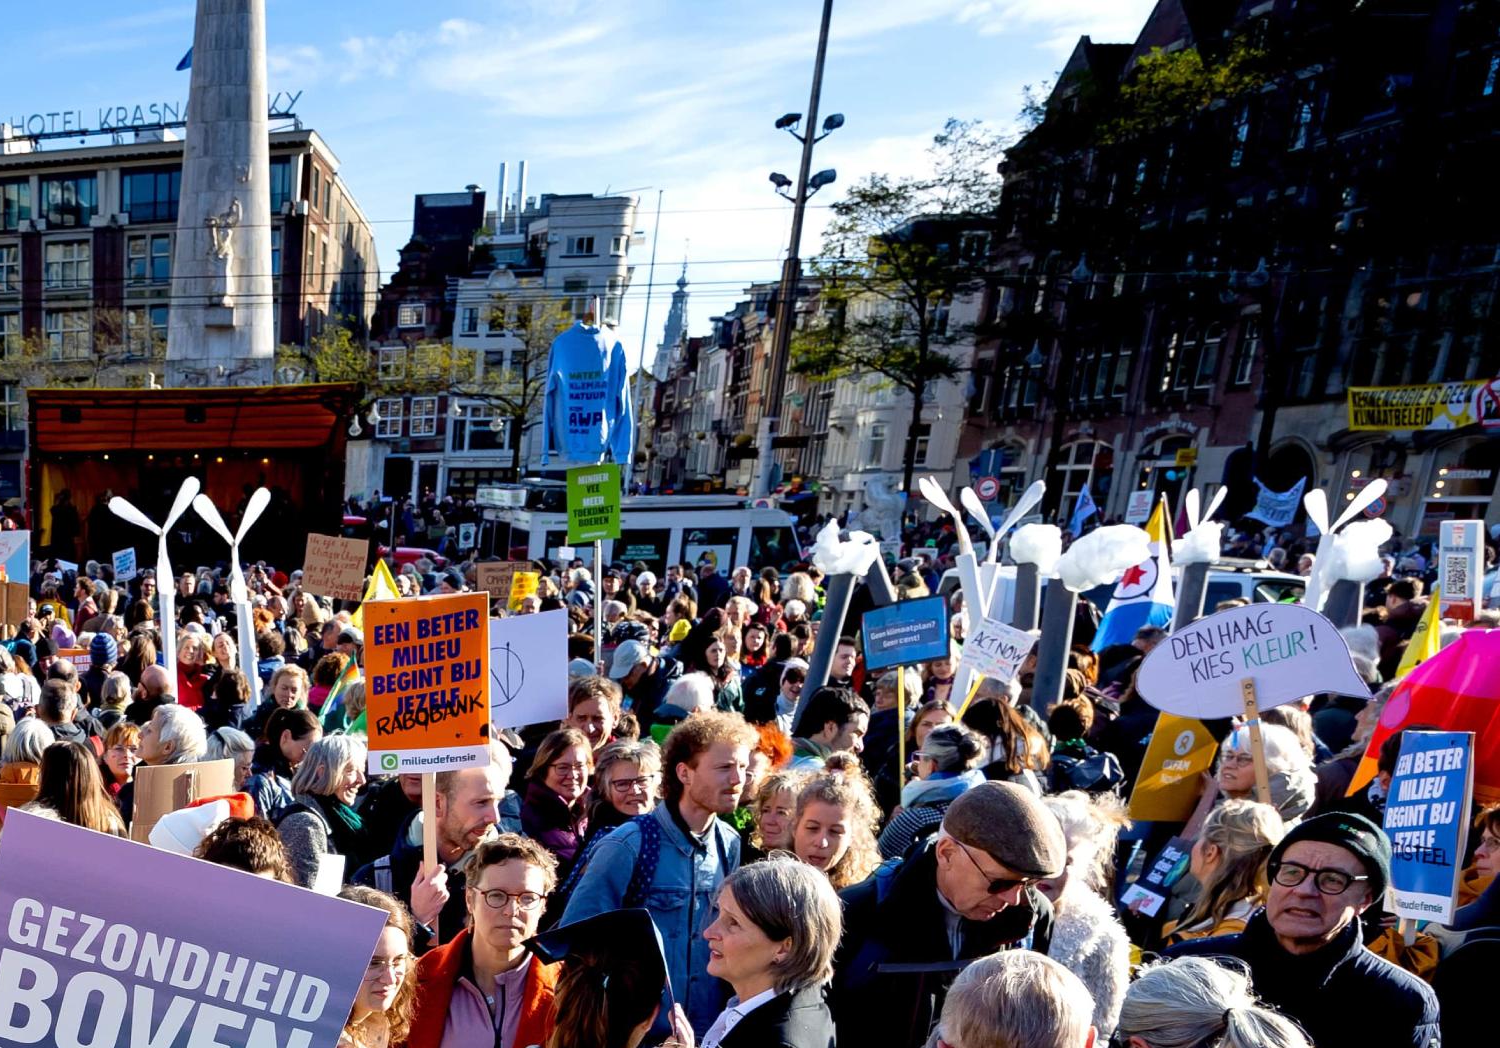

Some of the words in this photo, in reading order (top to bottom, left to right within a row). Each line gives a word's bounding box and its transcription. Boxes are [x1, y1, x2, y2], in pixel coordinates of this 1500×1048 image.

[10, 110, 88, 136] HOTEL
[569, 381, 607, 390] KLIMAA
[569, 411, 603, 426] AWP
[1353, 407, 1434, 426] KLIMAATBELEID
[578, 473, 609, 485] MINDER
[587, 484, 600, 493] VEE
[583, 496, 604, 507] MEER
[374, 622, 410, 646] EEN
[417, 608, 480, 639] BETER
[886, 620, 936, 639] klimaatplan?
[899, 634, 920, 645] cent!
[1171, 628, 1215, 660] DEN
[1218, 610, 1274, 648] HAAG
[392, 638, 461, 668] MILIEU
[972, 631, 998, 650] ACT
[997, 641, 1025, 661] NOW
[372, 666, 444, 695] BEGINT
[451, 659, 481, 683] BIJ
[1190, 651, 1235, 684] KIES
[376, 690, 484, 736] RABOBANK
[397, 687, 461, 718] JEZELF
[401, 753, 476, 766] milieudefensie
[1396, 753, 1412, 777] EEN
[1413, 748, 1464, 774] BETER
[1398, 776, 1447, 802] MILIEU
[1385, 804, 1428, 829] BEGINT
[1430, 802, 1456, 825] BIJ
[7, 897, 331, 1023] GEZONDHEID
